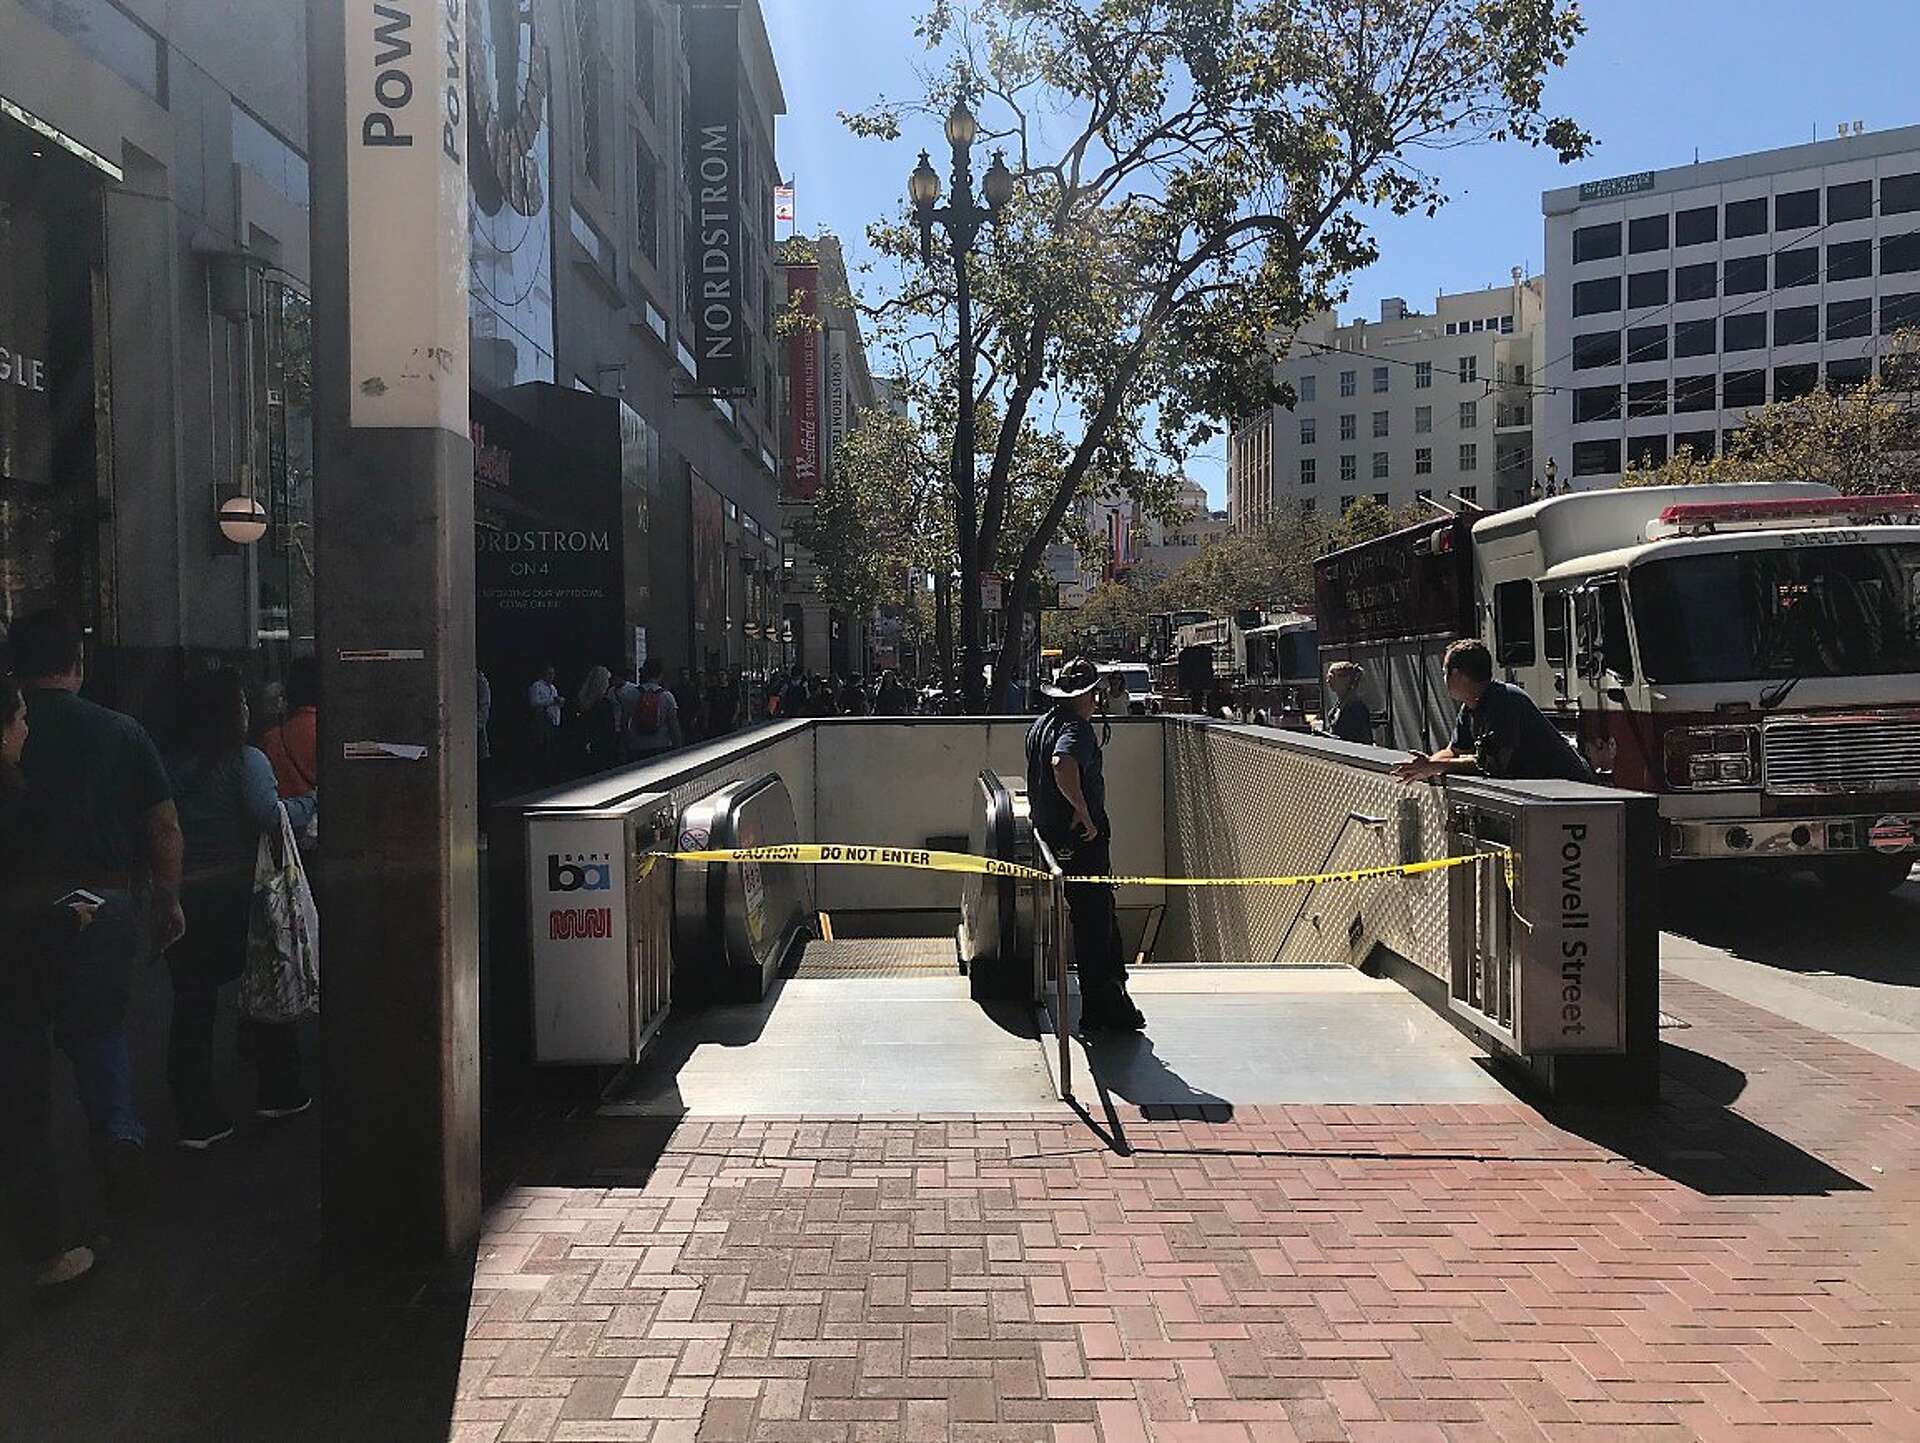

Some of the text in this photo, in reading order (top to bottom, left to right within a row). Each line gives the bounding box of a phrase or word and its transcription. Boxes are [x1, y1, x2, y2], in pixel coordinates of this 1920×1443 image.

[700, 124, 732, 358] NORDSTROM
[831, 352, 842, 426] NORDSTROM
[795, 419, 816, 480] Westfield
[511, 562, 550, 576] ON 4
[732, 846, 799, 860] CAUTION
[820, 846, 841, 860] DO
[846, 847, 877, 861] NOT
[881, 850, 930, 865] ENTER
[1561, 823, 1589, 1035] Powell Street
